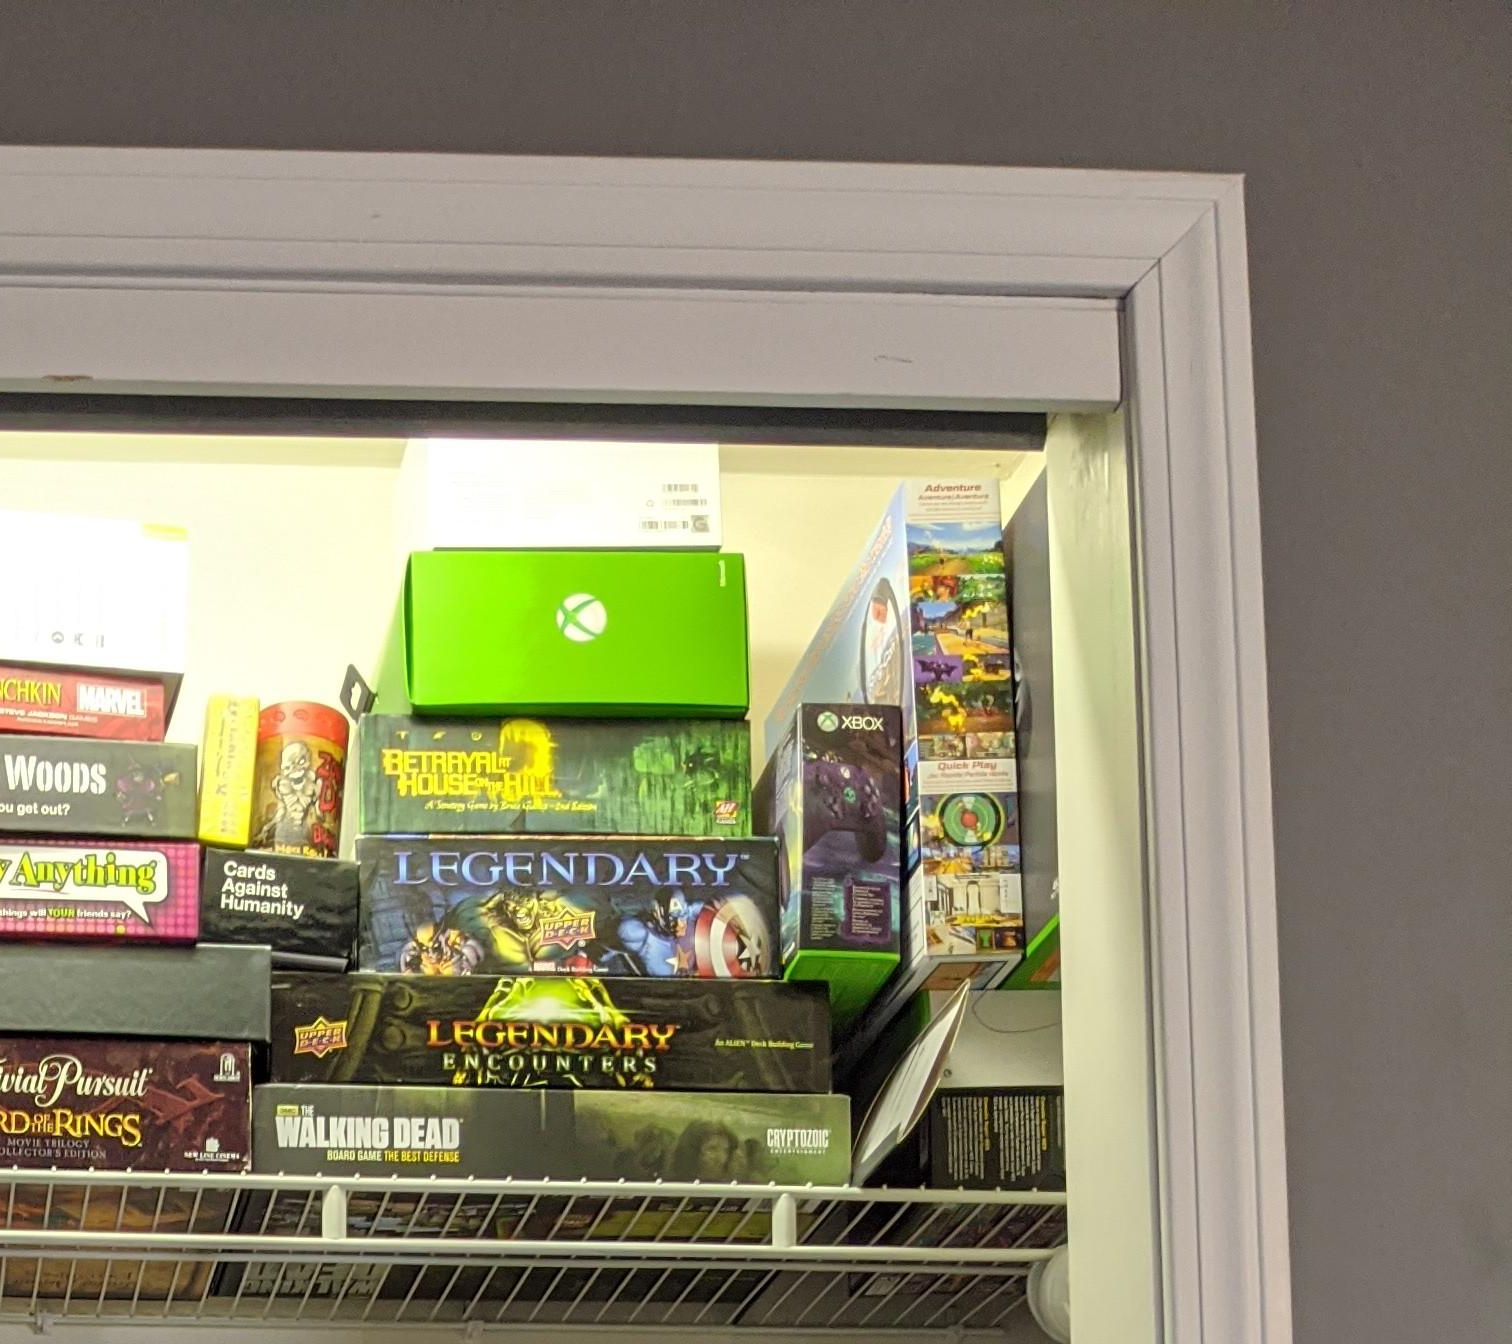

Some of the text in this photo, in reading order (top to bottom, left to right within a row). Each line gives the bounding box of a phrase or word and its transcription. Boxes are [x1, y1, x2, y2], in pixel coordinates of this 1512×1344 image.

[924, 484, 982, 492] Adventure
[78, 684, 145, 716] MARVEL
[841, 715, 884, 731] XBOX
[382, 748, 506, 775] BETRAYAL
[4, 754, 107, 795] WOODS
[398, 773, 477, 796] HOUSE
[16, 802, 39, 817] get
[41, 803, 71, 816] out?
[9, 850, 158, 895] Anything
[223, 860, 276, 881] Cards
[393, 852, 739, 887] LEGENDARY
[222, 878, 288, 899] Against
[0, 907, 28, 919] things
[29, 908, 46, 917] will
[47, 907, 75, 918] YOUR
[76, 908, 108, 918] friends
[110, 909, 132, 920] say?
[220, 893, 304, 920] Humanity
[545, 919, 589, 930] UPPER
[300, 1028, 342, 1039] UPPER
[426, 1020, 677, 1051] LEGENDARY
[715, 1038, 724, 1047] An
[768, 1041, 794, 1049] Building
[442, 1055, 658, 1074] ENCOUNTERS
[34, 1054, 149, 1108] Pursuit
[301, 1105, 314, 1117] THE
[34, 1114, 50, 1123] OF
[52, 1109, 142, 1147] RINGS
[275, 1116, 460, 1150] WALKING DEAD
[767, 1128, 829, 1148] CRYPTOZOIC
[7, 1138, 91, 1148] MOVIE TRILOGY
[64, 1149, 107, 1159] EDITION
[326, 1150, 460, 1163] BOARD GAME THE BEST DEFENSE
